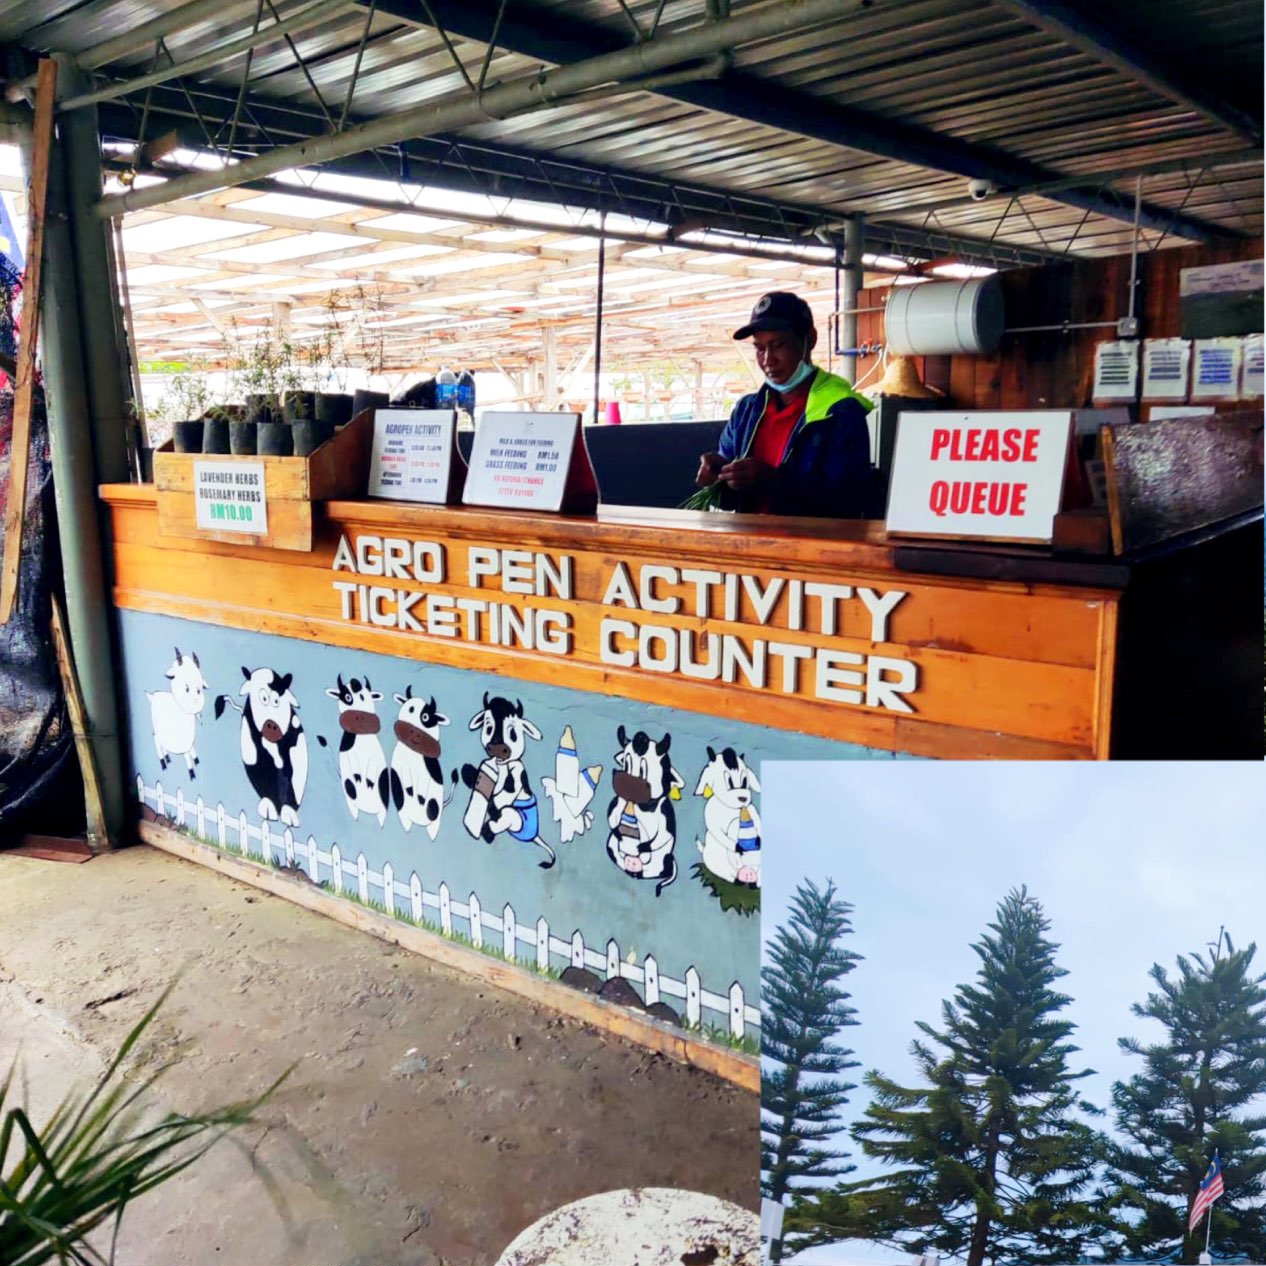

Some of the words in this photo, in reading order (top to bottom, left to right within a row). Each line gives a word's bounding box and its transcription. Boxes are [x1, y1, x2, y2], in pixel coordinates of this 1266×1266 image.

[504, 448, 528, 458] FEEDING
[930, 428, 1041, 463] PLEASE
[504, 461, 528, 470] FEEDING
[200, 471, 234, 484] LAVENDER
[235, 473, 259, 486] HERBS
[199, 487, 236, 500] ROSEMARY
[237, 489, 261, 503] HERBS
[928, 480, 1028, 517] QUEUE
[210, 503, 253, 522] RM10.00
[331, 532, 446, 584] AGRO
[467, 546, 576, 601] PEN
[602, 561, 909, 643] ACTIVITY
[332, 580, 573, 656] TICKETING
[600, 618, 922, 714] COUNTER
